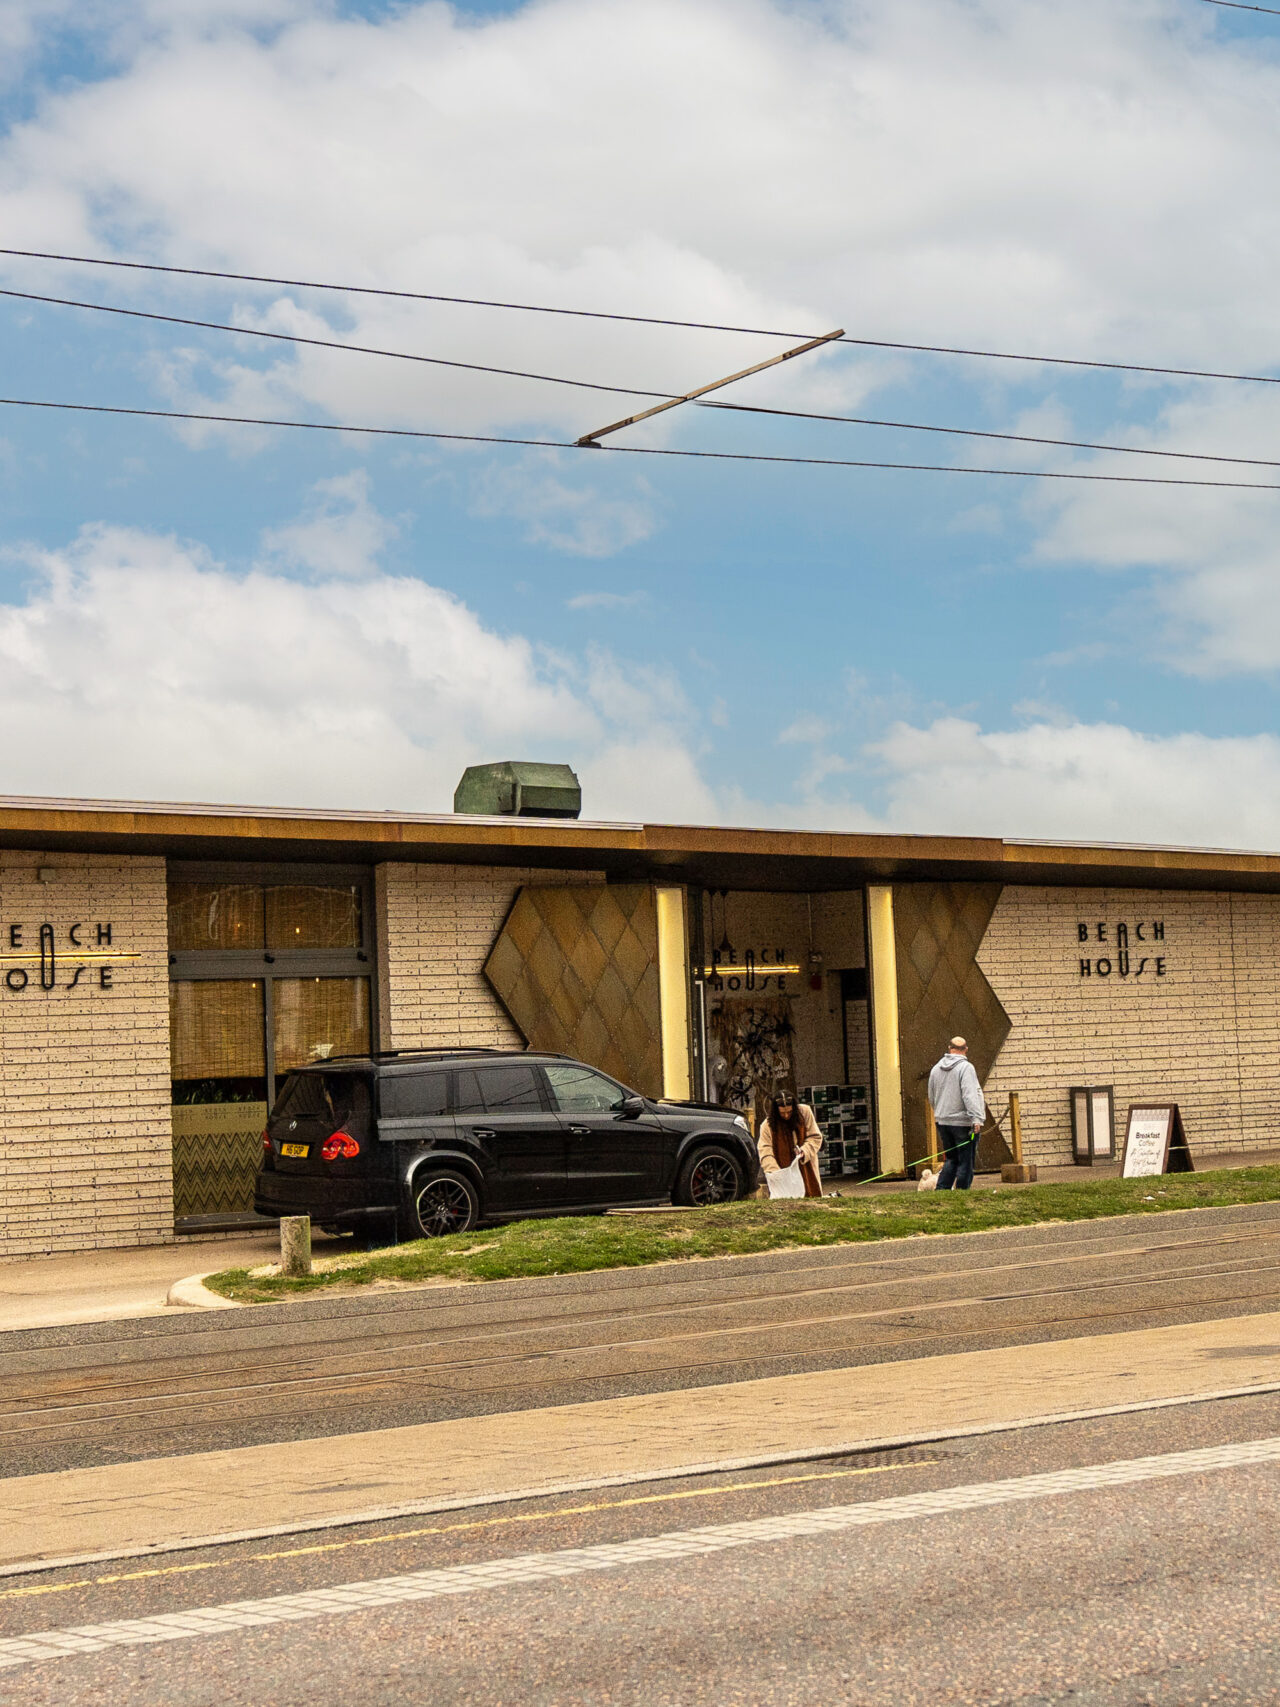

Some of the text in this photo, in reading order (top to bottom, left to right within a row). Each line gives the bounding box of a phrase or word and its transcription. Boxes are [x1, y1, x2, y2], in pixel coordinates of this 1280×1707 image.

[1078, 922, 1164, 942] BEACH
[714, 948, 784, 964] BEACH
[1080, 955, 1166, 976] HOUSE
[715, 974, 786, 991] HOUSE
